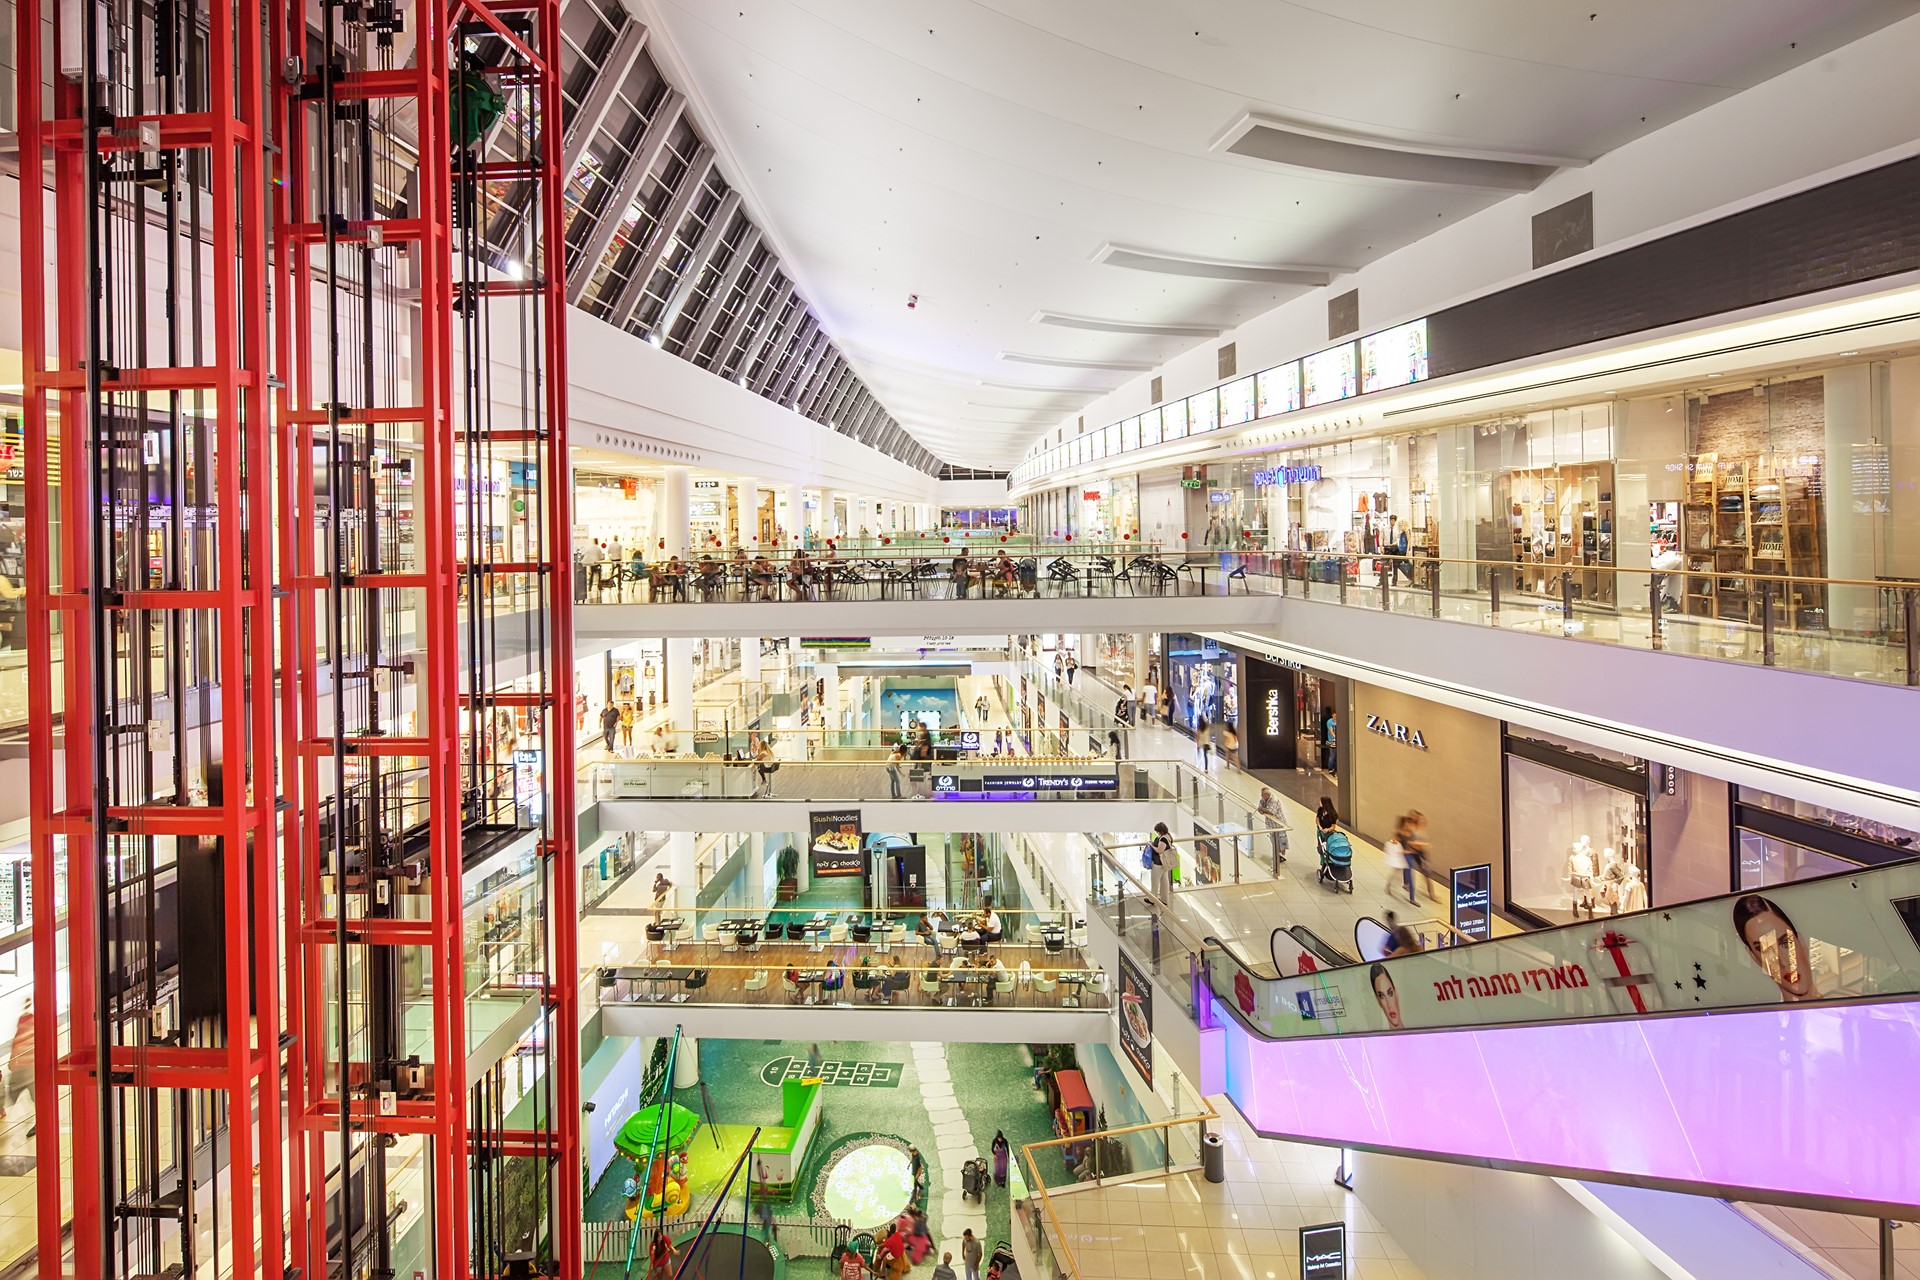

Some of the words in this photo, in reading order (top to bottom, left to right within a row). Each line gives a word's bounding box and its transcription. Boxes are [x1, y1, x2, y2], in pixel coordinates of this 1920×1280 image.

[1760, 542, 1784, 551] HOME
[1265, 689, 1279, 736] Bershka
[1365, 713, 1427, 748] ZARA
[1456, 889, 1487, 902] MAC
[1433, 975, 1465, 1002] לחג
[1467, 973, 1522, 998] מתנה
[1522, 963, 1590, 993] מארזי
[770, 1066, 779, 1075] 10
[604, 1087, 629, 1128] HITACHI
[1306, 1251, 1341, 1263] MAC
